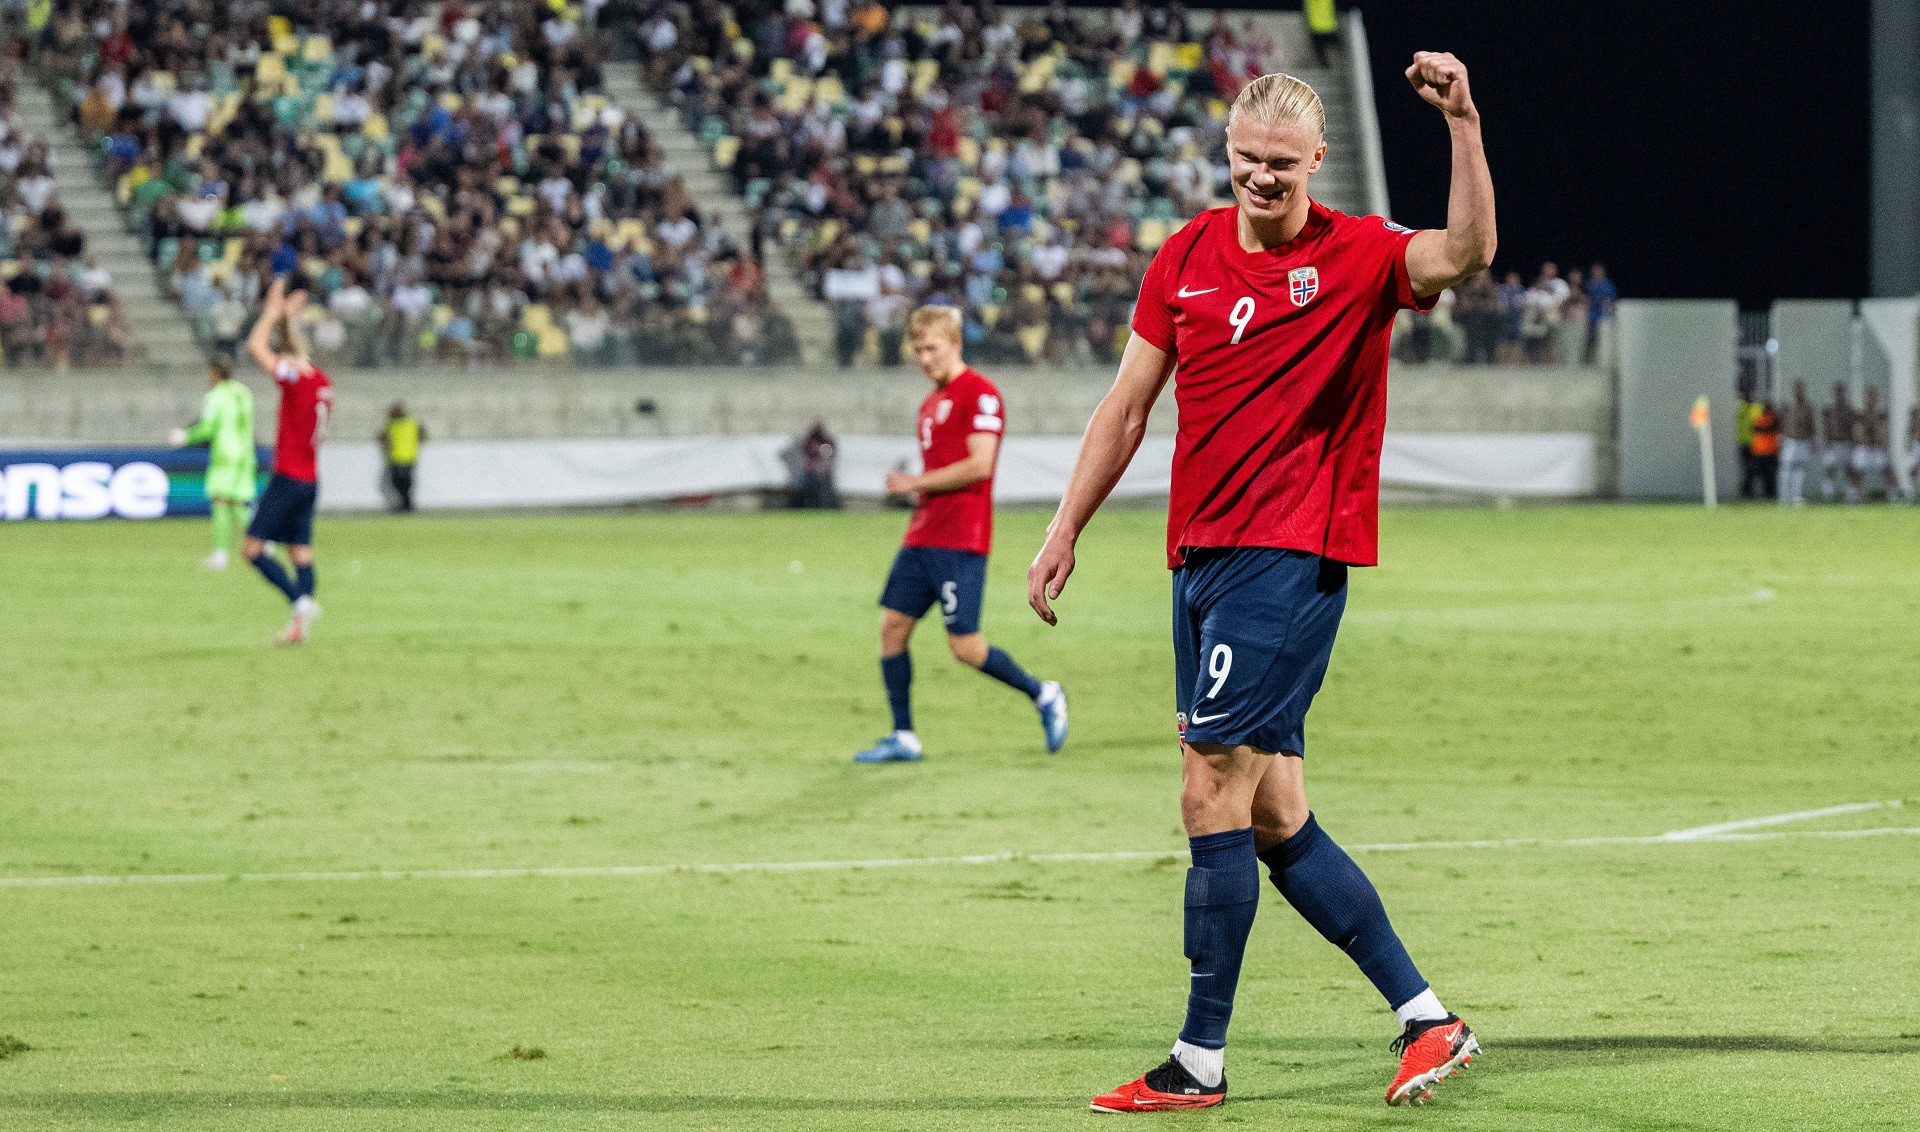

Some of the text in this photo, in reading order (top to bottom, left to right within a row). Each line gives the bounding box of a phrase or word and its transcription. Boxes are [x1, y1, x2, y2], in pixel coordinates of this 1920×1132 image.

[1229, 296, 1256, 345] 9
[0, 461, 169, 520] nse
[941, 580, 958, 614] 5
[1206, 643, 1233, 699] 9
